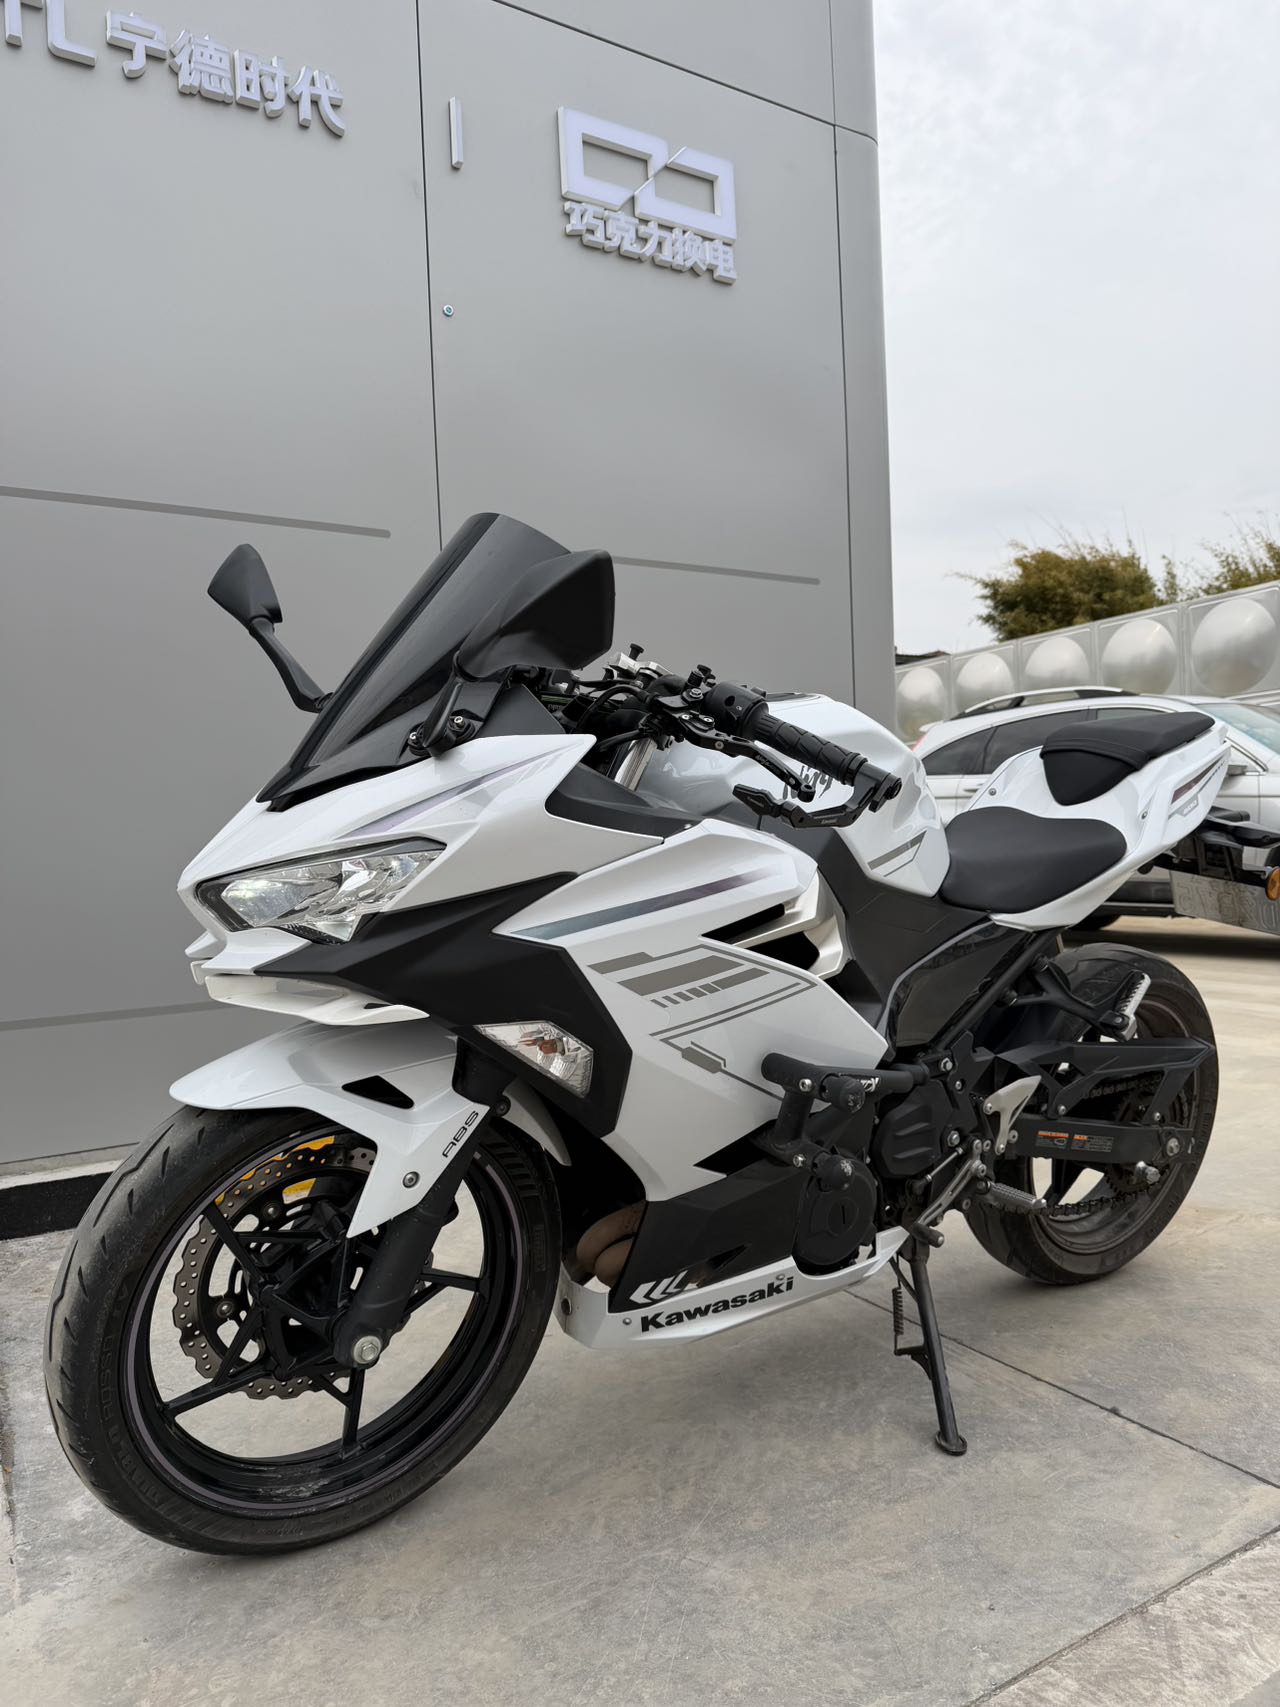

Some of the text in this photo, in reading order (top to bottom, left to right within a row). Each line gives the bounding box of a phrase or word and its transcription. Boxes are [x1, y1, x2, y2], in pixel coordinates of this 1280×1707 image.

[105, 8, 345, 138] 宁德时代
[563, 200, 737, 285] 巧克力换电
[442, 1110, 479, 1158] ABS
[640, 1275, 795, 1333] Kawasaki
